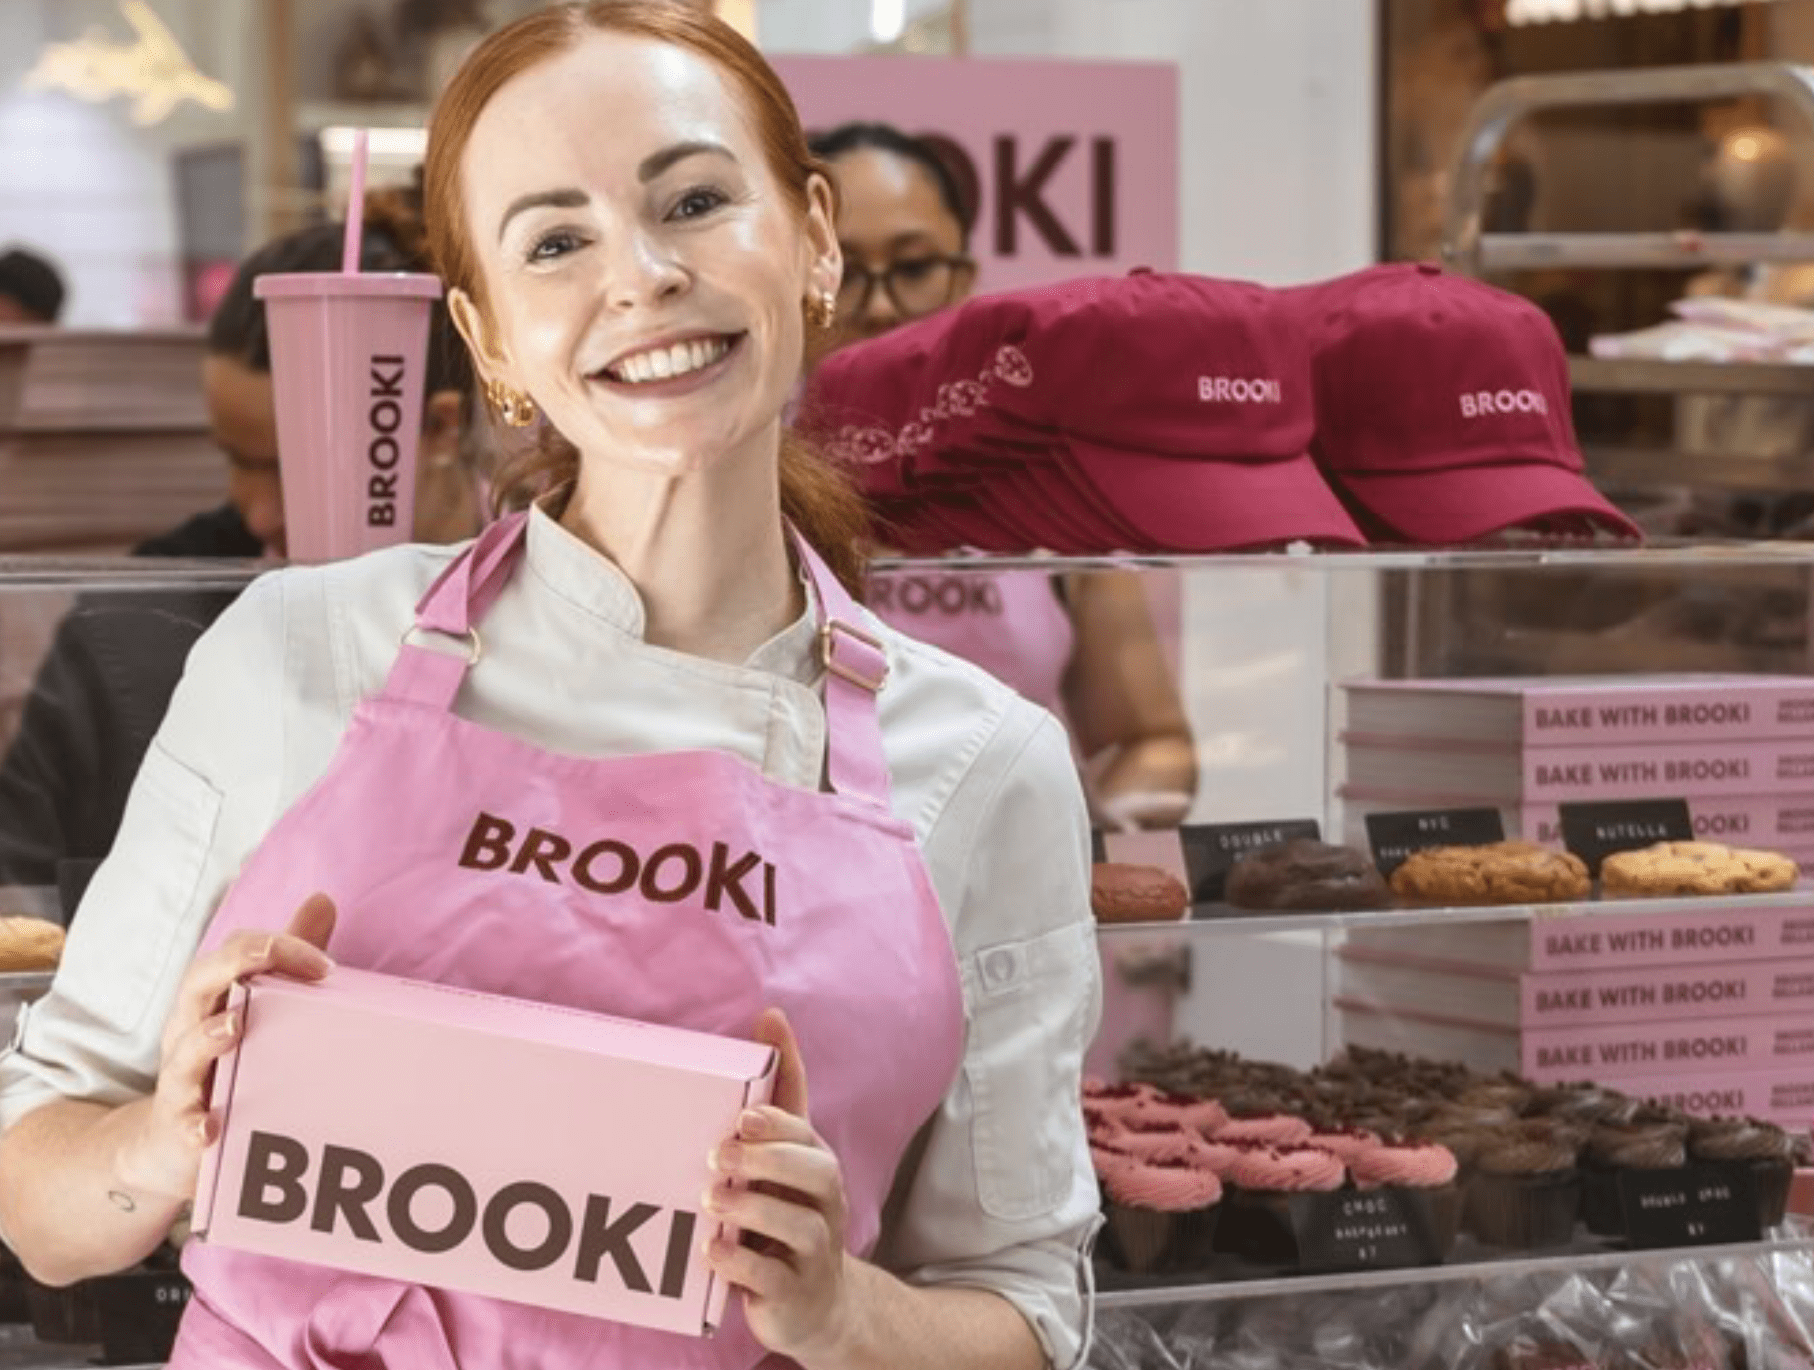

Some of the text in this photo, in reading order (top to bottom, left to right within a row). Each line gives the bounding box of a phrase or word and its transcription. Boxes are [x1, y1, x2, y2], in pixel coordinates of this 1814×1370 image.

[367, 354, 404, 528] BROOKI
[1535, 706, 1592, 729] BAKE
[1600, 704, 1658, 727] WITH
[1664, 701, 1750, 725] BROOKI
[1535, 763, 1592, 786] BAKE
[1600, 760, 1658, 783] WITH
[1664, 757, 1750, 781] BROOKI
[1596, 823, 1667, 840] NUTELLA
[457, 811, 776, 927] BROOKI
[1547, 933, 1601, 956] BAKE
[1608, 929, 1663, 951] WITH
[1671, 924, 1755, 949] BROOKI
[1536, 988, 1592, 1012] BAKE
[1600, 984, 1655, 1007] WITH
[1662, 979, 1747, 1004] BROOKI
[1536, 1044, 1593, 1068] BAKE
[1600, 1040, 1656, 1063] WITH
[1663, 1035, 1748, 1059] BROOKI
[237, 1130, 698, 1300] BROOKI
[1343, 1198, 1387, 1216] CHOC
